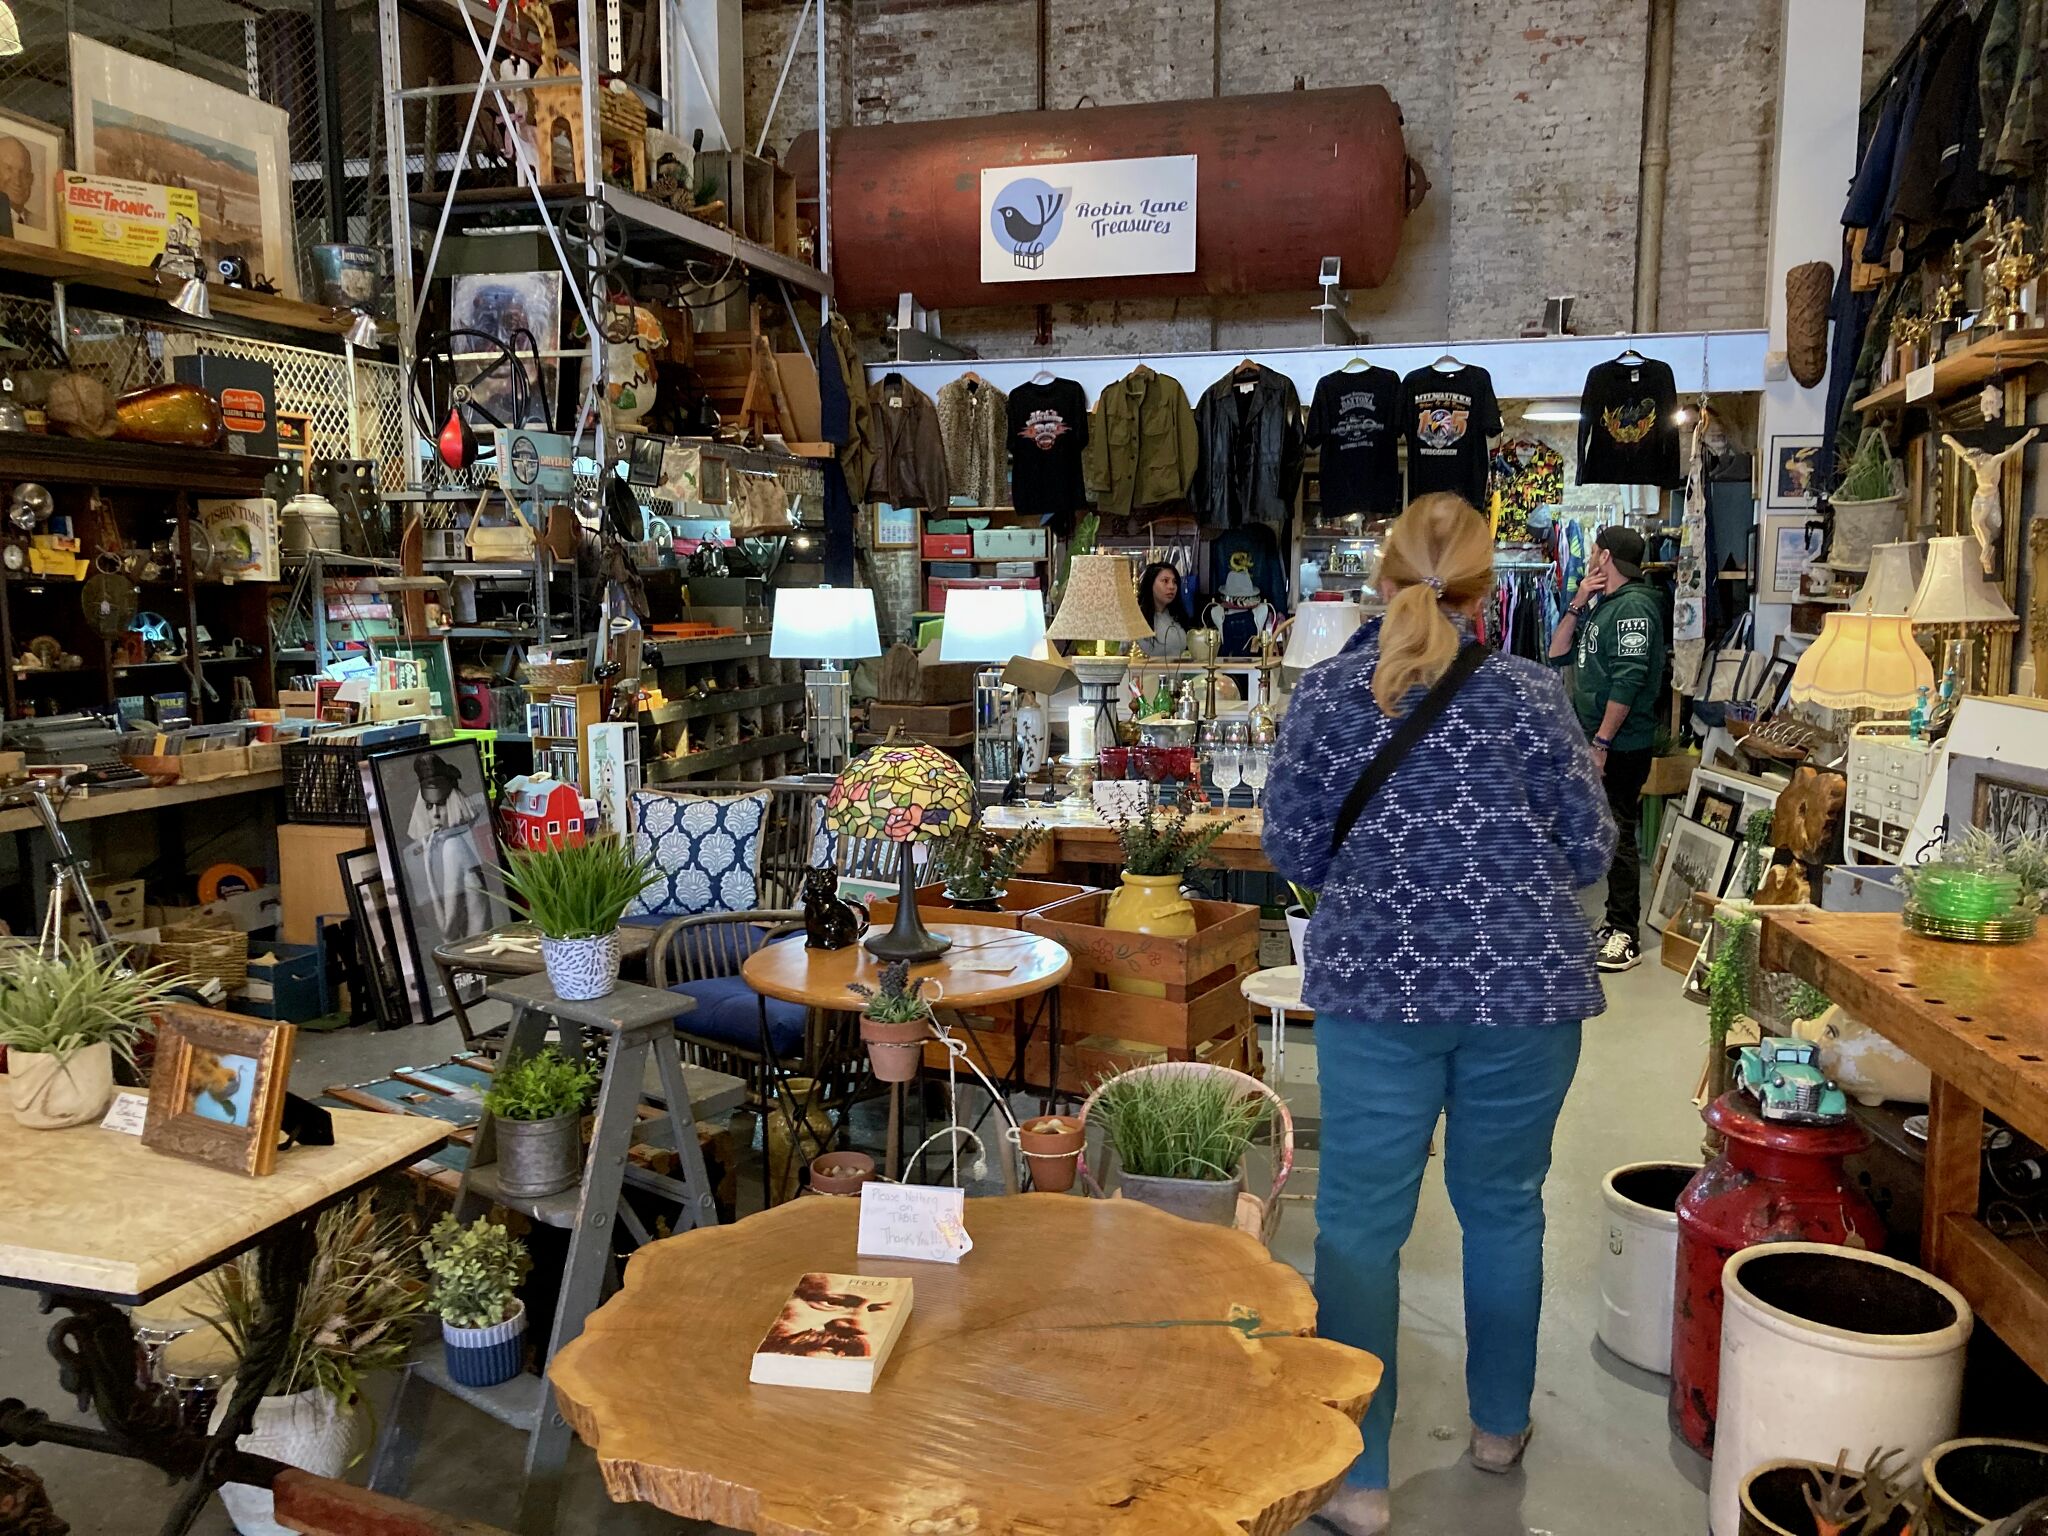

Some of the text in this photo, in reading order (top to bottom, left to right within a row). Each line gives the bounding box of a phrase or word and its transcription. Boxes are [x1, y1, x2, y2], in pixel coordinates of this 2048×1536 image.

[69, 186, 154, 217] ERECTRONIC
[1075, 199, 1188, 217] Robin Lane
[1091, 218, 1171, 238] Treasures
[1414, 392, 1471, 406] MILWAUKEE
[238, 506, 263, 531] TIME
[454, 973, 475, 990] FAME
[872, 1188, 939, 1215] Please Nothing
[880, 1227, 912, 1245] Thank
